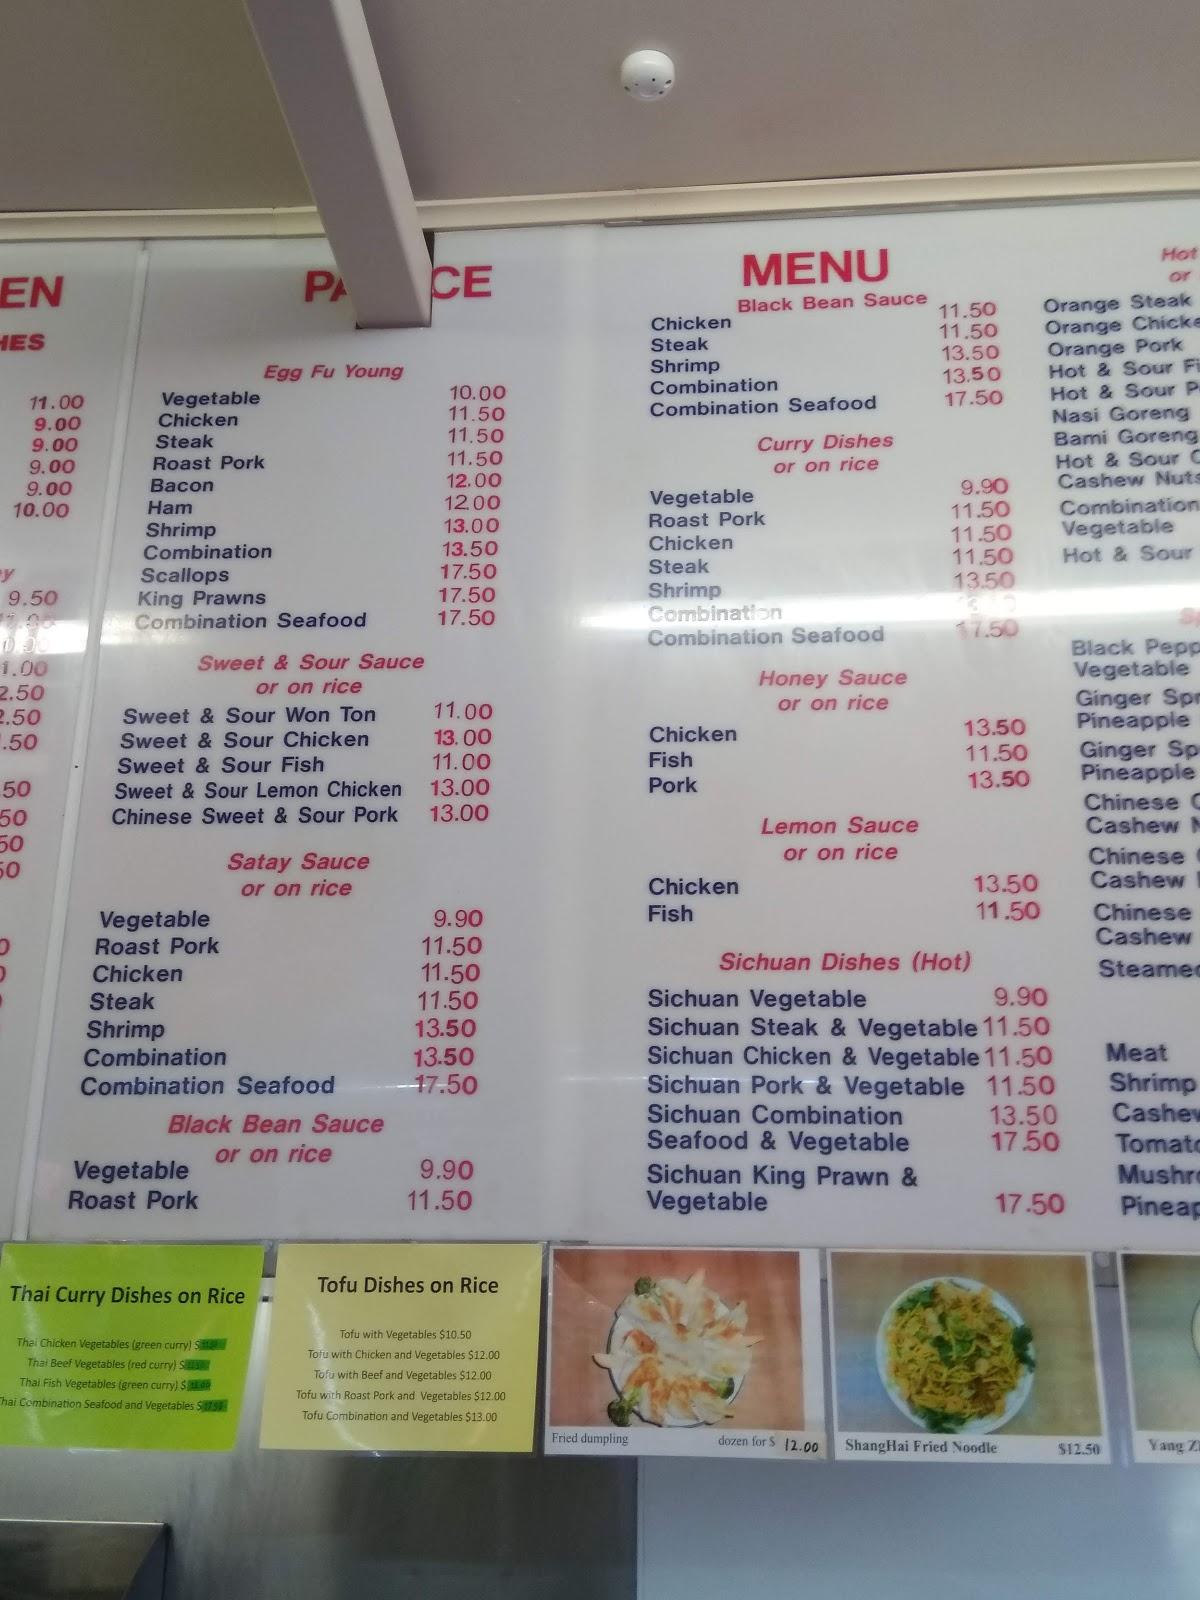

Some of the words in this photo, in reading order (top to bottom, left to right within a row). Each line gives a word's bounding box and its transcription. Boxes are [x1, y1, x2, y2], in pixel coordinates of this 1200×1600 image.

[743, 249, 888, 286] MENU
[738, 298, 792, 313] Black
[803, 296, 853, 309] Bean
[864, 293, 927, 307] Sauce
[1044, 299, 1119, 314] Orange
[1131, 293, 1191, 309] Steak
[1048, 342, 1124, 358] Orange
[1136, 338, 1182, 352] Pork
[651, 359, 719, 374] Shrimp
[942, 345, 1000, 360] 13.50
[264, 365, 303, 382] Egg
[311, 365, 335, 378] Fu
[346, 364, 404, 381] Young
[31, 395, 84, 410] 11.00
[162, 391, 260, 408] Vegetable
[450, 385, 506, 401] 10.00
[650, 400, 778, 417] Combination
[789, 395, 876, 412] Seafood
[945, 390, 1003, 406] 17.50
[35, 416, 81, 432] 9.00
[1053, 408, 1098, 423] Nasi
[1109, 406, 1190, 422] Goreng
[758, 437, 814, 453] Curry
[823, 434, 893, 449] Dishes
[1054, 430, 1107, 446] Bami
[1118, 429, 1198, 445] Goreng
[153, 457, 211, 470] Roast
[221, 455, 264, 469] Pork
[448, 450, 503, 467] 11.50
[650, 489, 753, 508] Vegetable
[961, 478, 1008, 495] 9.90
[14, 502, 69, 518] 10.00
[146, 523, 216, 539] Shrimp
[445, 518, 499, 533] 13.00
[1062, 519, 1174, 539] Vegetable
[198, 655, 264, 671] Sweet
[274, 655, 288, 670] &
[300, 654, 350, 670] Sour
[359, 653, 424, 669] Sauce
[759, 671, 828, 689] Honey
[838, 669, 907, 685] Sauce
[123, 708, 189, 724] Sweet
[200, 708, 214, 723] &
[226, 707, 275, 723] Sour
[286, 707, 329, 722] Won
[340, 706, 375, 722] Ton
[435, 701, 492, 720] 11.00
[650, 752, 692, 768] Fish
[966, 744, 1028, 761] 11.50
[112, 808, 192, 825] Chinese
[202, 808, 264, 824] Sweet
[274, 807, 287, 823] &
[299, 807, 344, 823] Sour
[355, 806, 398, 822] Pork
[430, 804, 489, 822] 13.00
[761, 818, 836, 834] Lemon
[848, 816, 918, 833] Sauce
[228, 853, 292, 873] Satay
[301, 852, 369, 870] Sauce
[720, 952, 810, 971] Sichuan
[822, 953, 900, 971] Dishes
[912, 951, 970, 972] (Hot)
[90, 992, 154, 1010] Steak
[419, 991, 478, 1011] 11.50
[648, 989, 738, 1007] Sichuan
[750, 989, 866, 1011] Vegetable
[994, 986, 1048, 1007] 9.90
[1106, 1043, 1167, 1062] Meat
[81, 1076, 224, 1096] Combination
[237, 1076, 334, 1095] Seafood
[414, 1074, 478, 1095] 17.50
[1110, 1072, 1197, 1096] Shrimp
[168, 1115, 232, 1134] Black
[242, 1114, 301, 1133] Bean
[312, 1114, 384, 1133] Sauce
[215, 1149, 240, 1163] or
[250, 1148, 278, 1163] on
[288, 1144, 332, 1163] rice
[74, 1160, 189, 1184] Vegetable
[421, 1159, 474, 1180] 9.90
[647, 1164, 740, 1184] Sichuan
[753, 1165, 805, 1189] King
[817, 1166, 888, 1186] Prawn
[902, 1167, 917, 1187] &
[646, 1190, 767, 1215] Vegetable
[996, 1193, 1065, 1215] 17.50
[318, 1276, 357, 1293] Tofu
[365, 1276, 424, 1293] Dishes
[431, 1281, 453, 1293] on
[461, 1277, 498, 1293] Rice
[11, 1285, 50, 1302] Thai
[56, 1286, 105, 1307] Curry
[112, 1286, 172, 1303] Dishes
[178, 1292, 201, 1303] on
[208, 1288, 245, 1304] Rice
[17, 1337, 37, 1347] Thai
[40, 1338, 76, 1348] Chicken
[80, 1339, 129, 1351] Vegetables
[132, 1339, 162, 1351] (green
[165, 1340, 191, 1351] curry)
[340, 1329, 360, 1338] Tofu
[363, 1330, 383, 1339] with
[386, 1329, 436, 1341] Vegetables
[440, 1329, 471, 1340] $10.50
[28, 1358, 48, 1367] Thai
[51, 1359, 72, 1368] Beef
[75, 1360, 125, 1370] Vegetables
[128, 1360, 146, 1370] (red
[149, 1360, 177, 1372] curry)
[308, 1350, 328, 1358] Tofu
[332, 1350, 352, 1358] with
[355, 1350, 391, 1359] Chicken
[394, 1350, 412, 1359] and
[415, 1350, 465, 1361] Vegetables
[468, 1350, 500, 1360] $12.00
[20, 1378, 40, 1387] Thai
[43, 1378, 62, 1387] Fish
[65, 1379, 117, 1390] Vegetables
[118, 1380, 148, 1391] (green
[151, 1380, 178, 1392] curry)
[314, 1370, 335, 1379] Tofu
[338, 1370, 358, 1379] with
[362, 1370, 383, 1379] Beef
[386, 1370, 403, 1380] and
[406, 1371, 456, 1382] Vegetables
[460, 1370, 491, 1381] $12.00
[19, 1397, 81, 1408] Combination
[84, 1400, 122, 1409] Seafood
[125, 1400, 143, 1409] and
[145, 1401, 194, 1412] Vegetables
[296, 1390, 316, 1399] Tofu
[320, 1391, 341, 1399] with
[344, 1391, 370, 1400] Roast
[374, 1391, 394, 1400] Pork
[397, 1391, 415, 1400] and
[421, 1392, 471, 1402] Vegetables
[474, 1392, 505, 1401] $12.00
[302, 1411, 323, 1420] Tofu
[326, 1411, 388, 1421] Combination
[391, 1412, 409, 1421] and
[412, 1412, 462, 1423] Vegetables
[466, 1412, 497, 1422] $13.00
[552, 1433, 577, 1443] Fried
[581, 1433, 628, 1446] dumpling
[718, 1435, 748, 1446] dozen
[752, 1436, 767, 1446] for
[786, 1438, 818, 1453] 12.00
[846, 1439, 908, 1454] ShangHai
[914, 1441, 947, 1452] Fried
[952, 1441, 997, 1453] Noodle
[1059, 1443, 1100, 1455] $12.50
[1149, 1439, 1184, 1455] Yang
